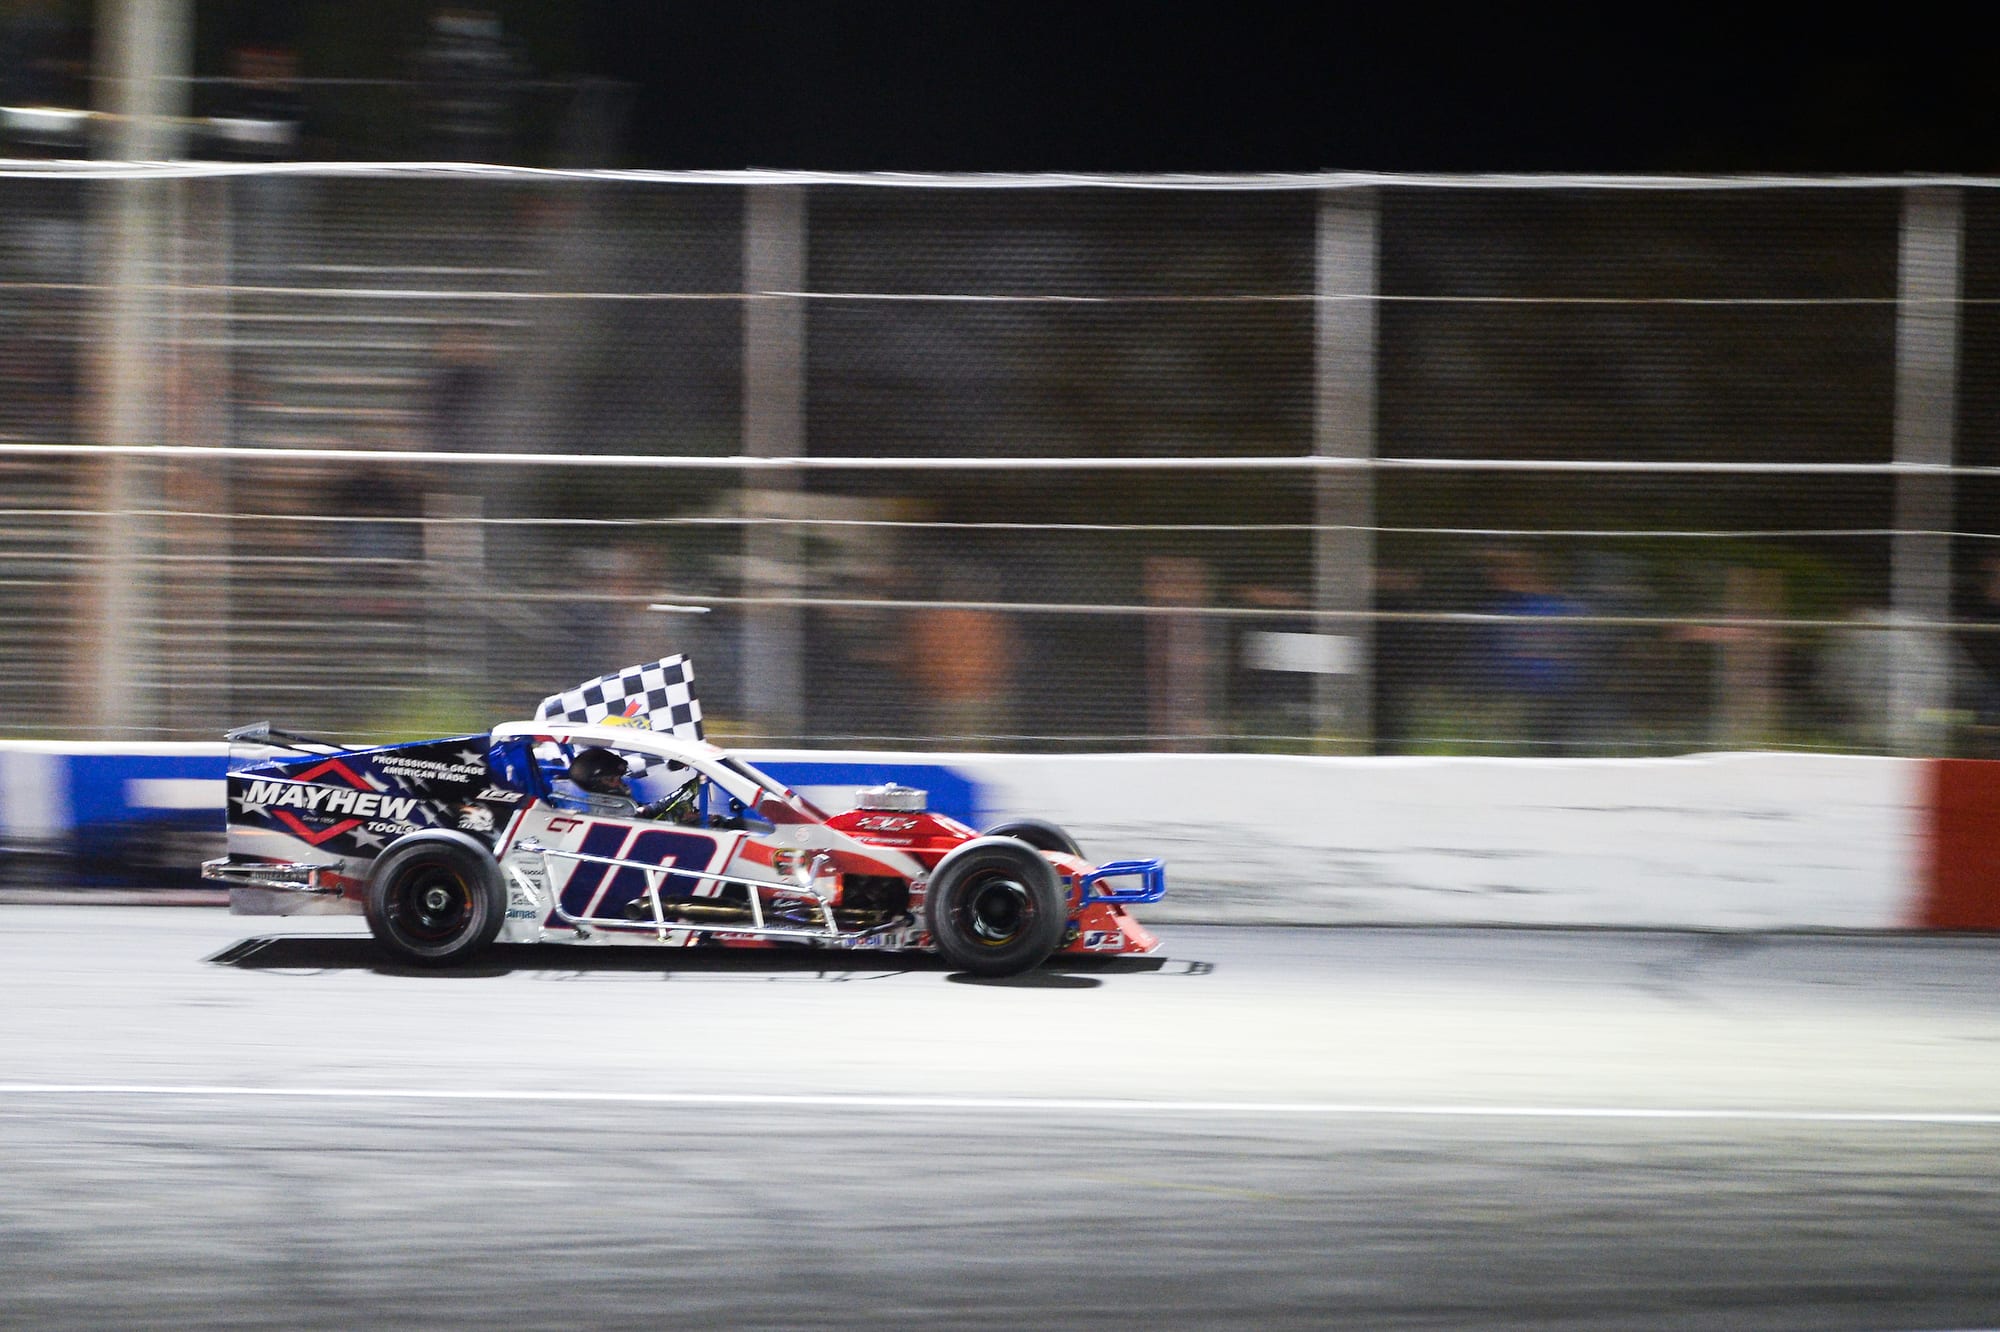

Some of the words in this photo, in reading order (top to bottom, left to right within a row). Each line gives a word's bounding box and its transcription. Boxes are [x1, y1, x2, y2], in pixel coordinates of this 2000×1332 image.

[372, 755, 449, 771] PROFESSIONAL
[449, 763, 486, 776] GRADE
[382, 766, 435, 779] AMERICAN
[245, 780, 418, 821] MAYHEW
[367, 821, 417, 835] TOOLS
[546, 817, 584, 833] CT
